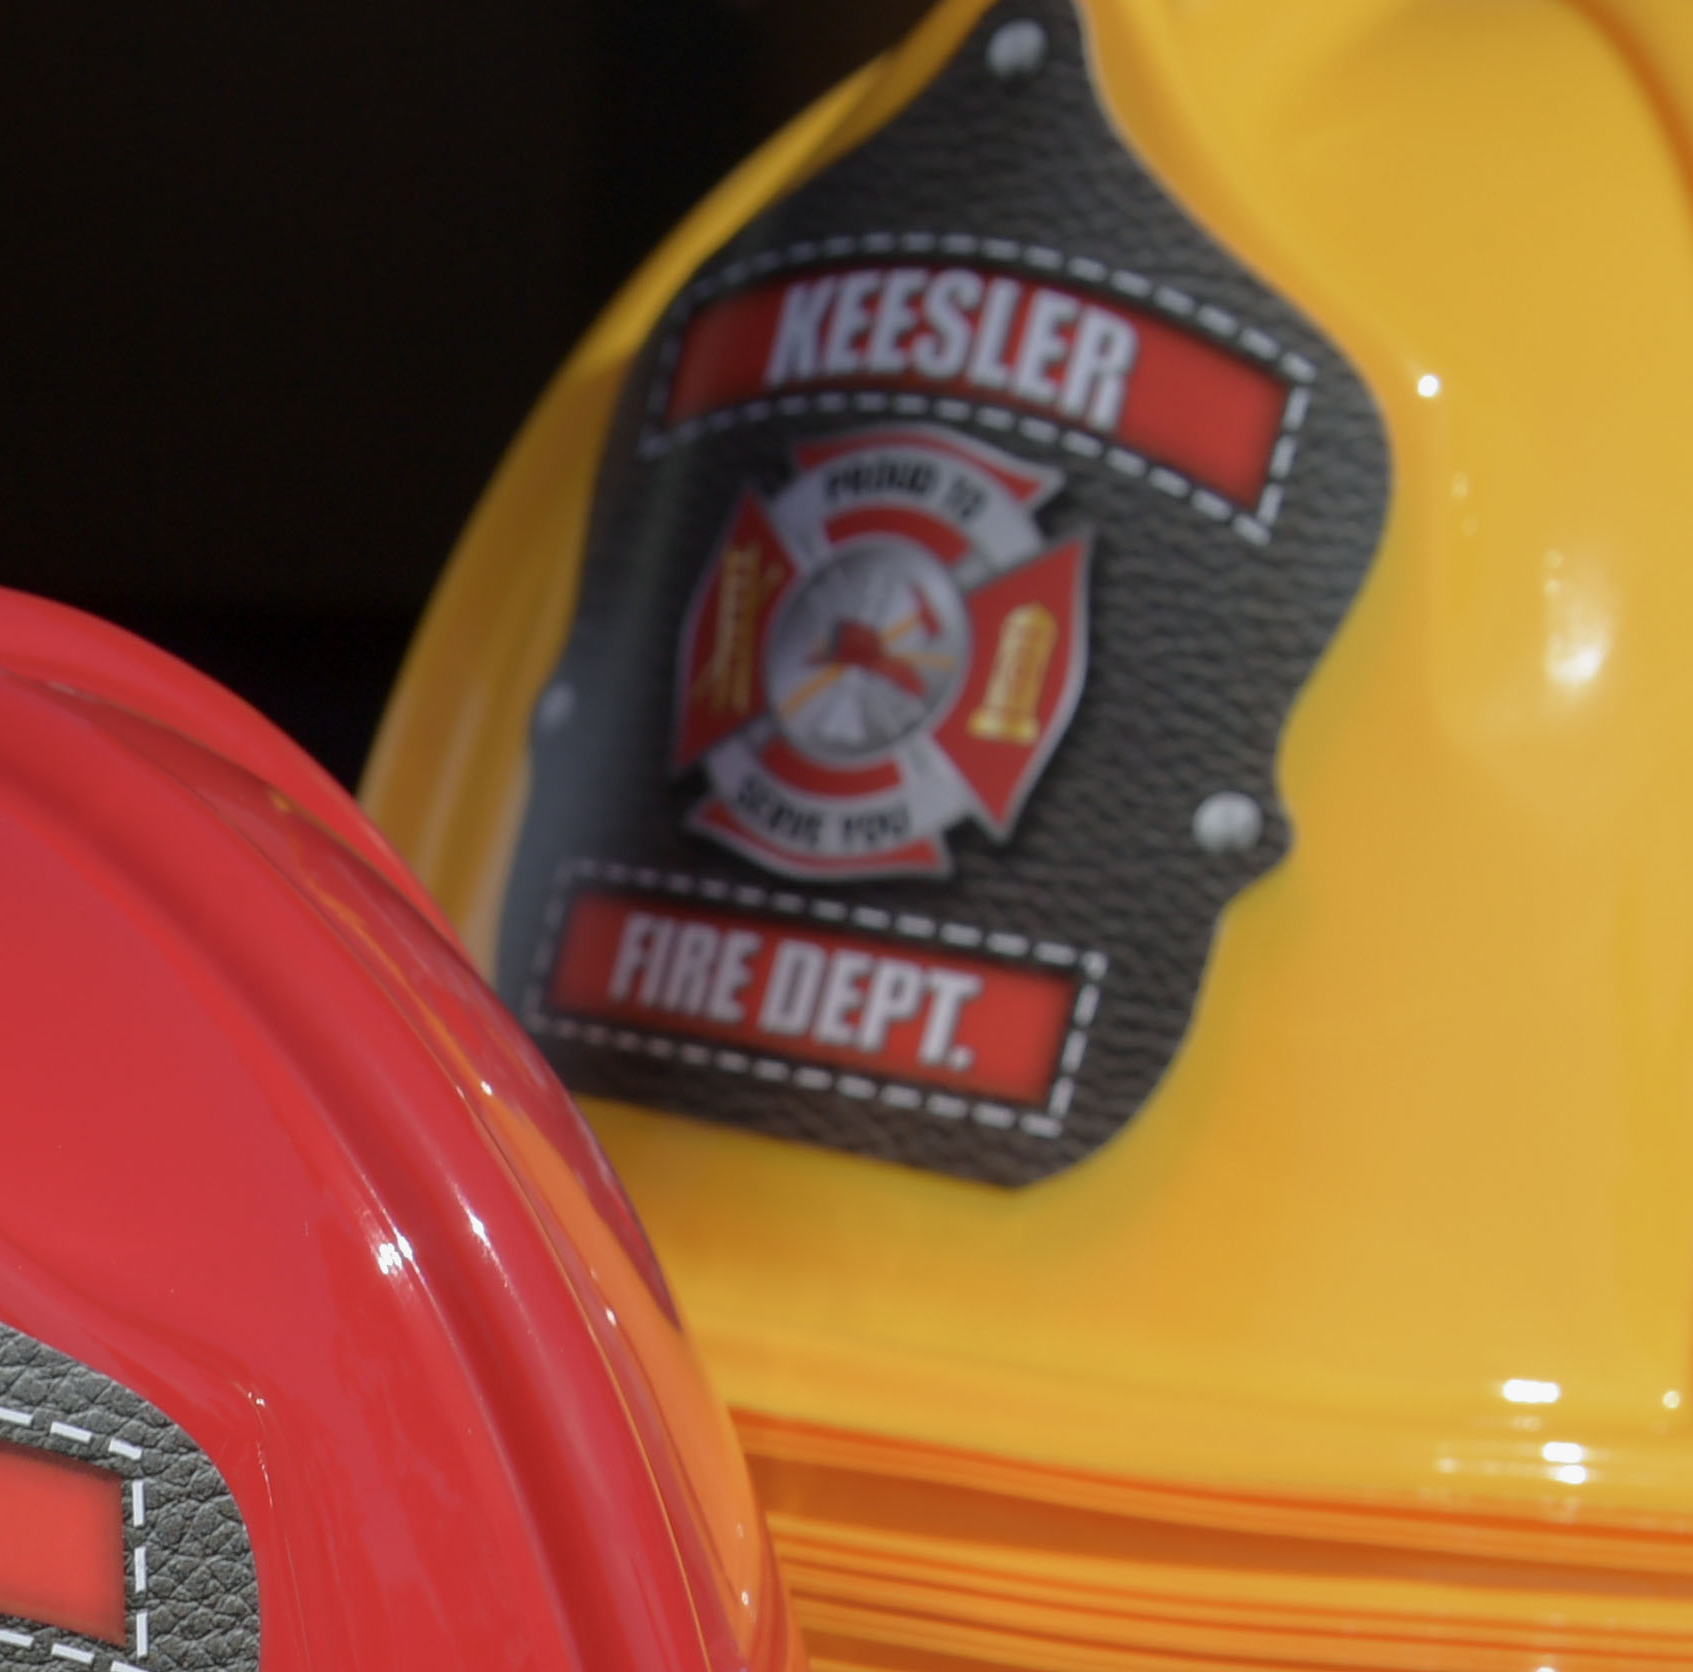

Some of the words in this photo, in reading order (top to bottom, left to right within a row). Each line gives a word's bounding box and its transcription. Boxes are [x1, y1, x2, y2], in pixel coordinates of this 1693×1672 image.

[766, 269, 1136, 429] KEESLER
[609, 912, 758, 1024] FIRE
[761, 943, 982, 1073] DEPT.
